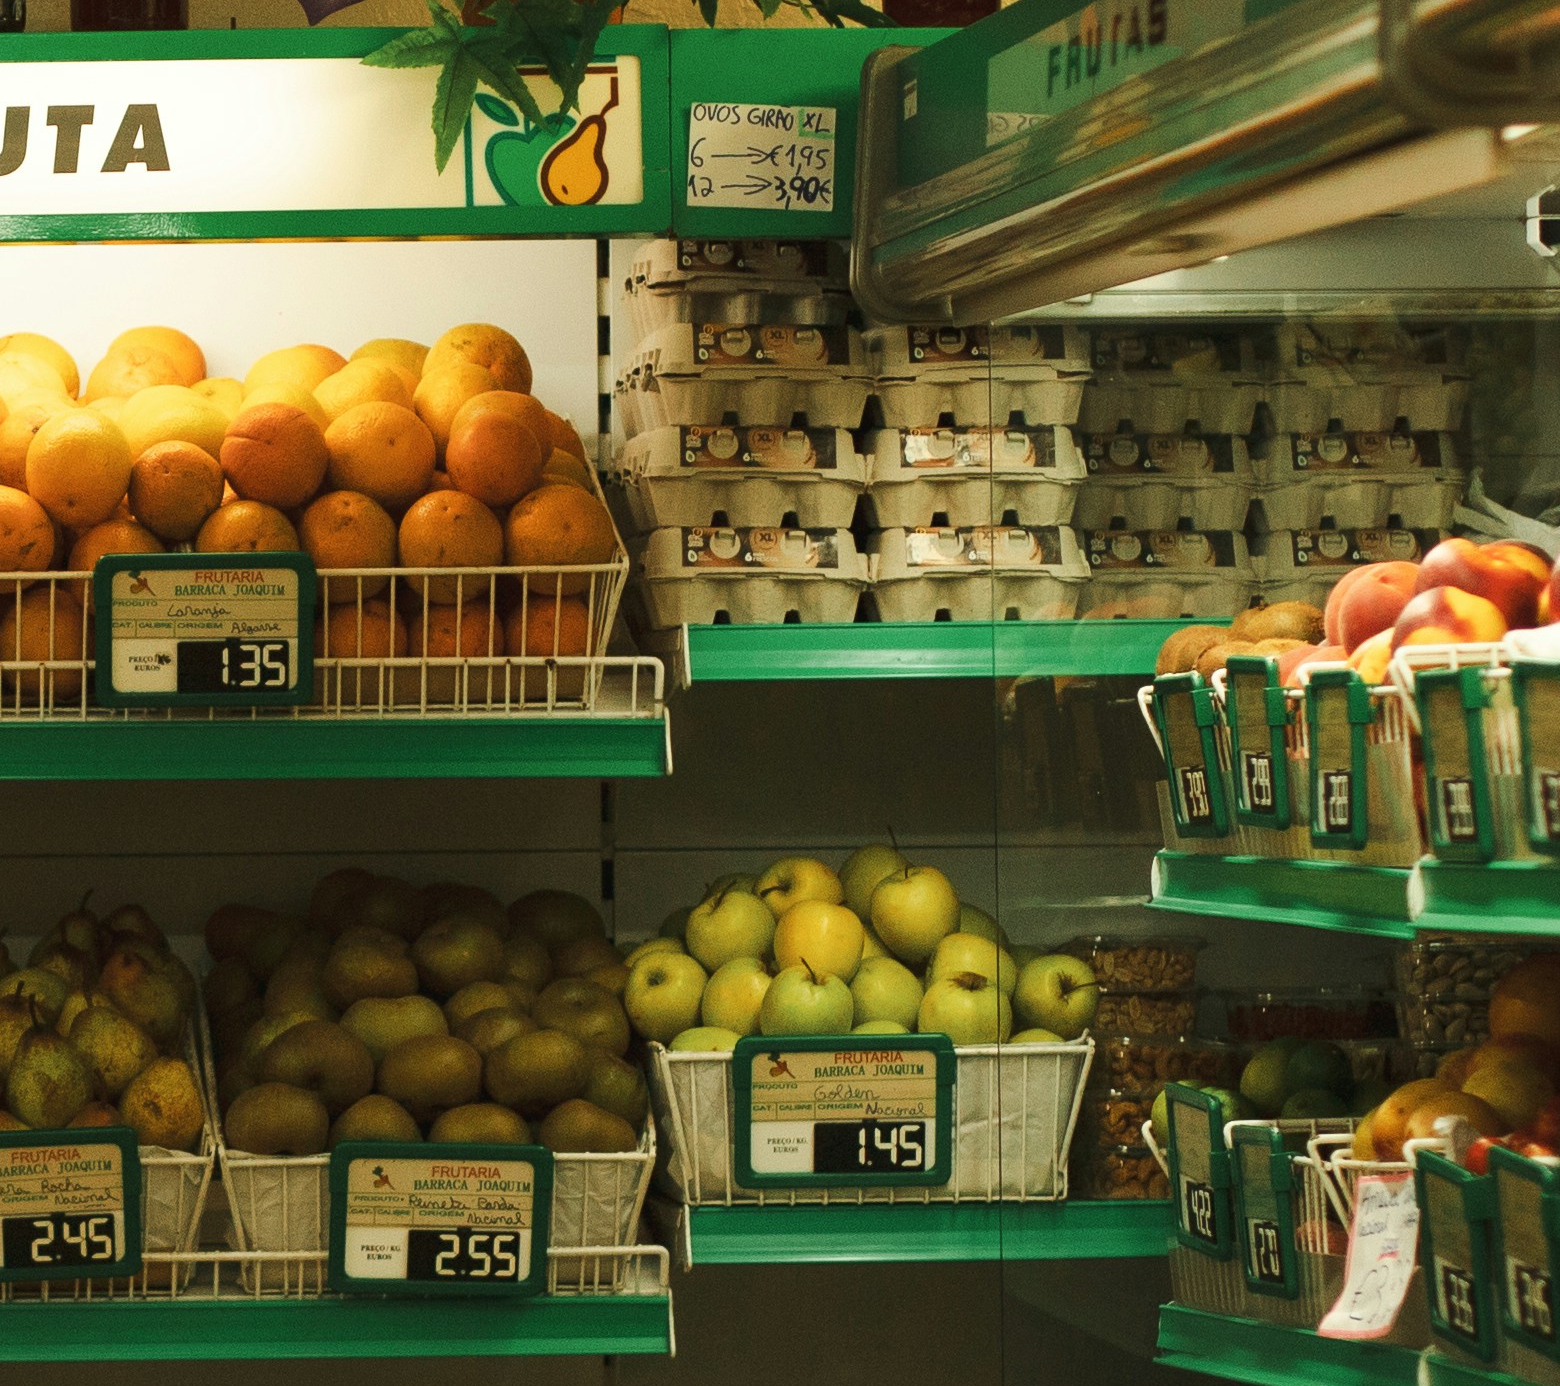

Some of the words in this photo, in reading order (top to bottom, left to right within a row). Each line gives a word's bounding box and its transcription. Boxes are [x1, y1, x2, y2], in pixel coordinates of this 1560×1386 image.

[693, 104, 740, 124] OVOS
[803, 113, 829, 133] XL
[691, 138, 706, 167] 6
[771, 144, 829, 175] €1,95
[688, 175, 714, 197] 12
[195, 572, 264, 583] FRUTARIA
[175, 585, 226, 595] BARRACA
[233, 585, 285, 596] JOAQUIM
[167, 603, 232, 618] Laranja
[834, 1052, 903, 1063] FRUTARIA
[814, 1065, 865, 1078] BARRACA
[872, 1064, 924, 1076] JOAQUIM
[814, 1084, 880, 1101] Golden
[859, 1125, 922, 1166] 1.45
[11, 1149, 81, 1163] FRUTARIA
[57, 1160, 112, 1174] JOAQUIM
[431, 1166, 501, 1179] FRUTARIA
[41, 1179, 92, 1193] Rocha
[414, 1180, 468, 1191] BARRACA
[477, 1181, 530, 1192] JOAQUIM
[32, 1218, 112, 1262] 2.45
[436, 1235, 516, 1277] 2.55
